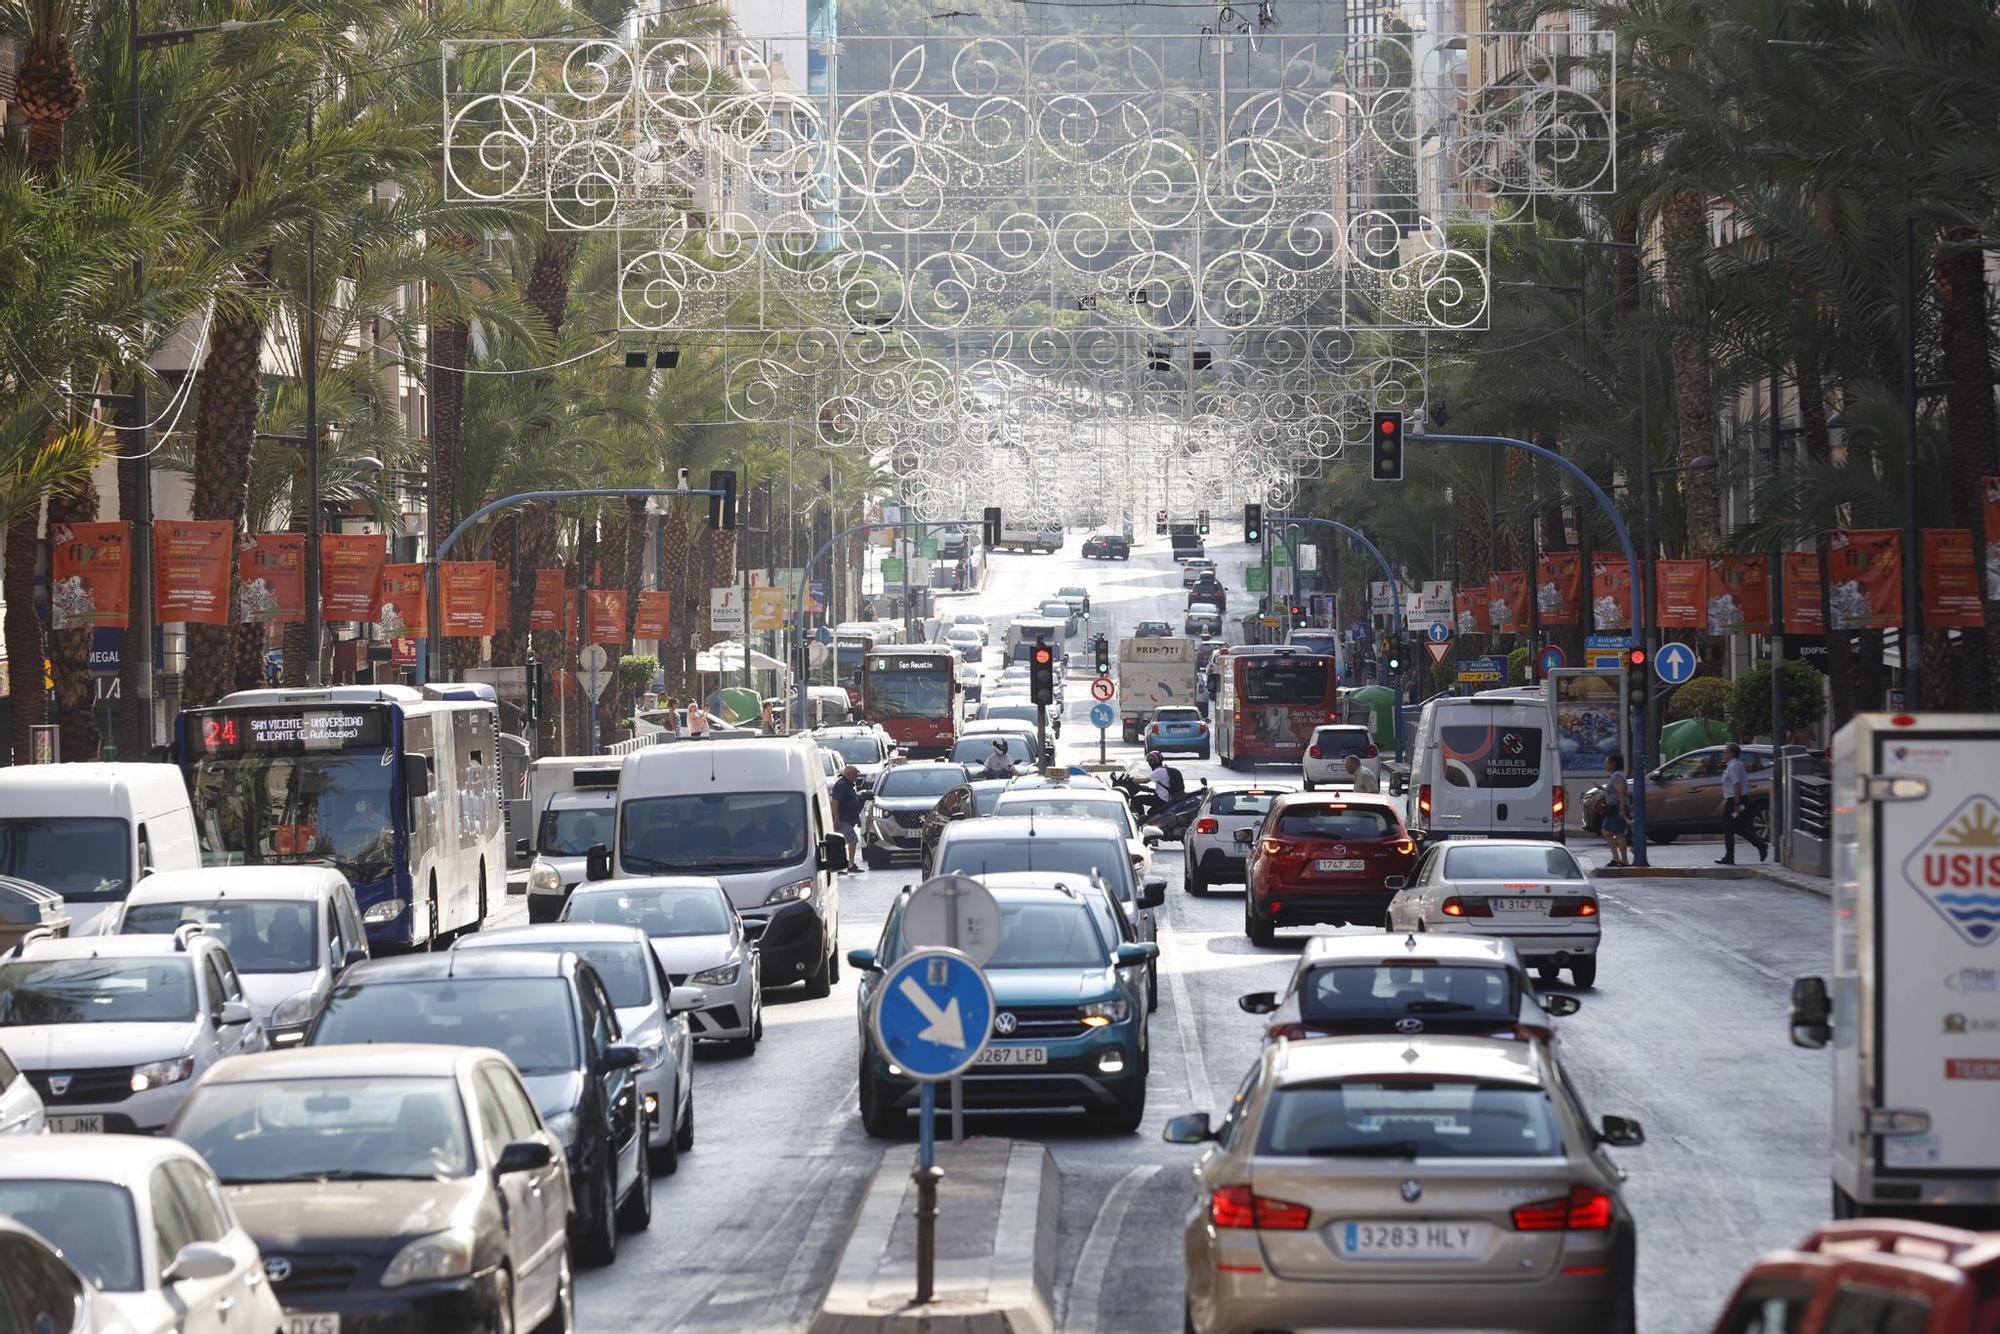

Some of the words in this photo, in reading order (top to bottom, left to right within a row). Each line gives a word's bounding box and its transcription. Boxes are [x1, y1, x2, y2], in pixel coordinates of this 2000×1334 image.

[878, 660, 886, 670] 5
[251, 719, 268, 730] SAN
[269, 718, 302, 730] VICENTE
[310, 716, 363, 728] UNIVERSIDAD
[204, 720, 237, 746] 24
[256, 730, 295, 741] ALICANTE
[309, 729, 358, 740] Autobuses)
[1487, 759, 1526, 767] MUEBLES
[1486, 767, 1539, 776] BALLESTERO
[1323, 860, 1344, 869] 1747
[1509, 900, 1530, 910] 3147
[1016, 1048, 1043, 1062] LFD
[70, 1117, 98, 1133] JNK
[1361, 1226, 1419, 1248] 3283
[1427, 1226, 1471, 1249] HLY
